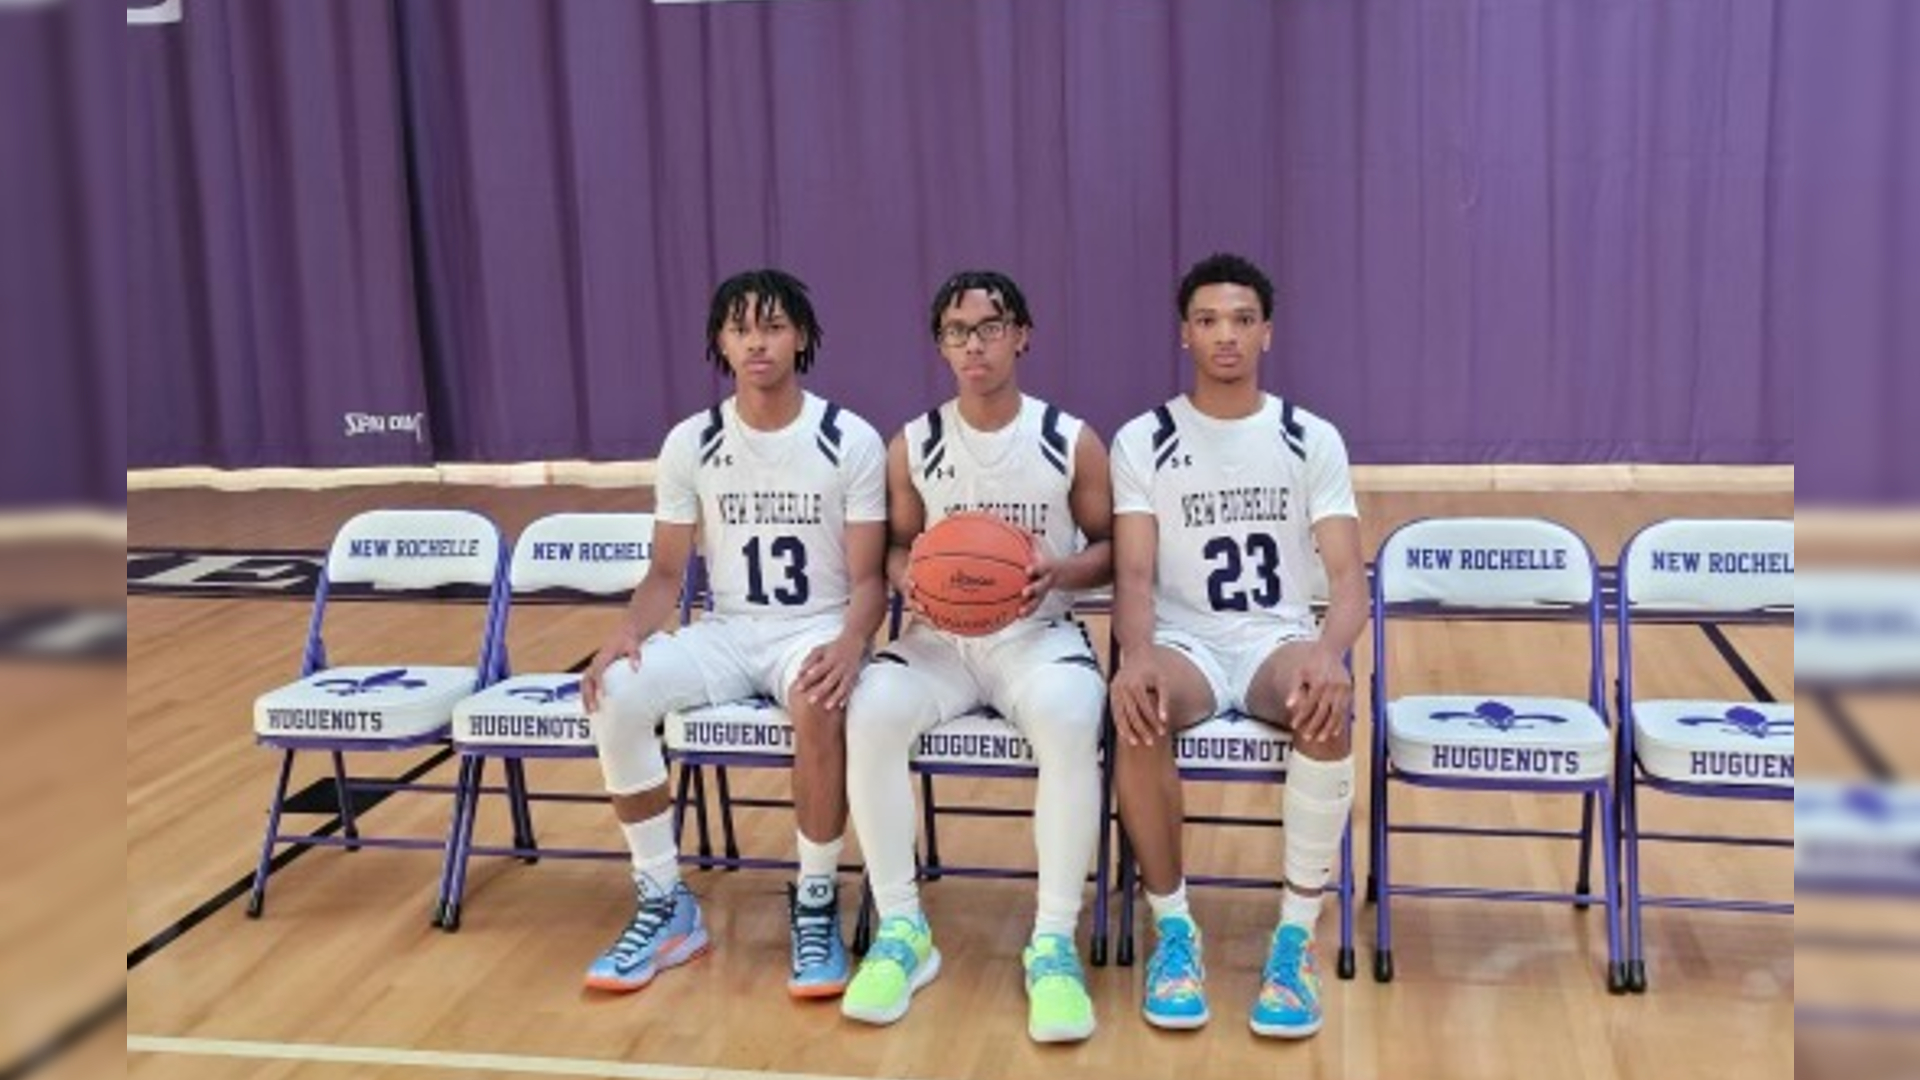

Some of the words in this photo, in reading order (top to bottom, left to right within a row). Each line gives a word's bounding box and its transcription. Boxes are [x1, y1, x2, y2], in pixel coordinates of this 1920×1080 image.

[1182, 491, 1216, 527] NEW
[1219, 486, 1290, 523] ROCHELLE
[349, 540, 391, 557] NEW
[395, 538, 480, 557] ROCHELLE
[532, 542, 574, 560] NEW
[1406, 549, 1453, 570] NEW
[1460, 549, 1567, 571] ROCHELLE
[742, 535, 809, 606] 13
[1203, 532, 1280, 612] 23
[1652, 552, 1701, 573] NEW
[268, 708, 383, 733] HUGUENOTS
[469, 714, 591, 740] HUGUENOTS
[1432, 745, 1580, 774] HUGUENOTS
